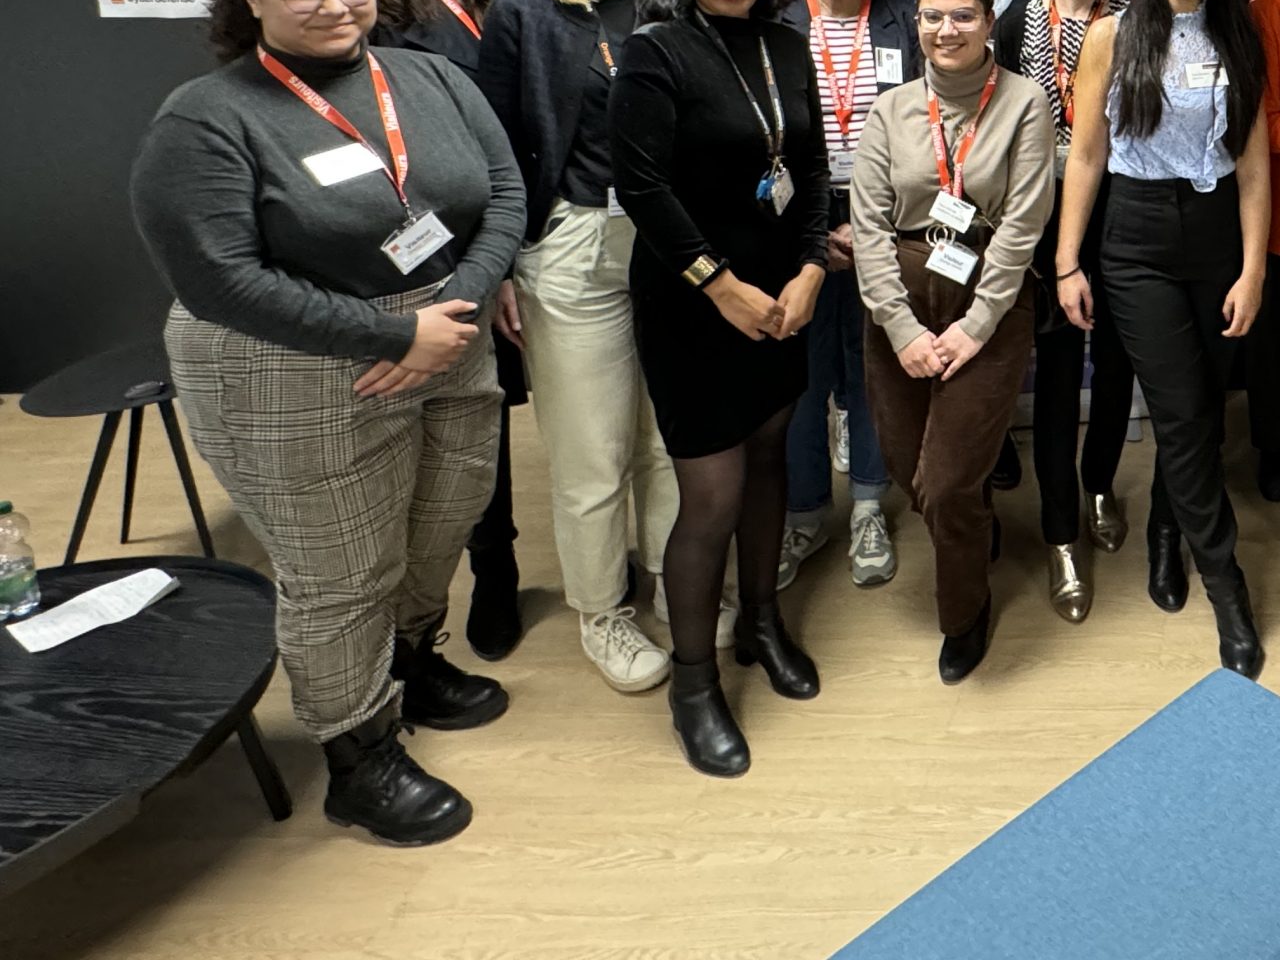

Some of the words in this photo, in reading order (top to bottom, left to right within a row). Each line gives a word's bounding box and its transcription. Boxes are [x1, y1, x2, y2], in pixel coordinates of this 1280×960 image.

[288, 75, 331, 115] Visiteurs
[381, 92, 399, 131] Visiteurs
[931, 122, 946, 160] Visiteurs
